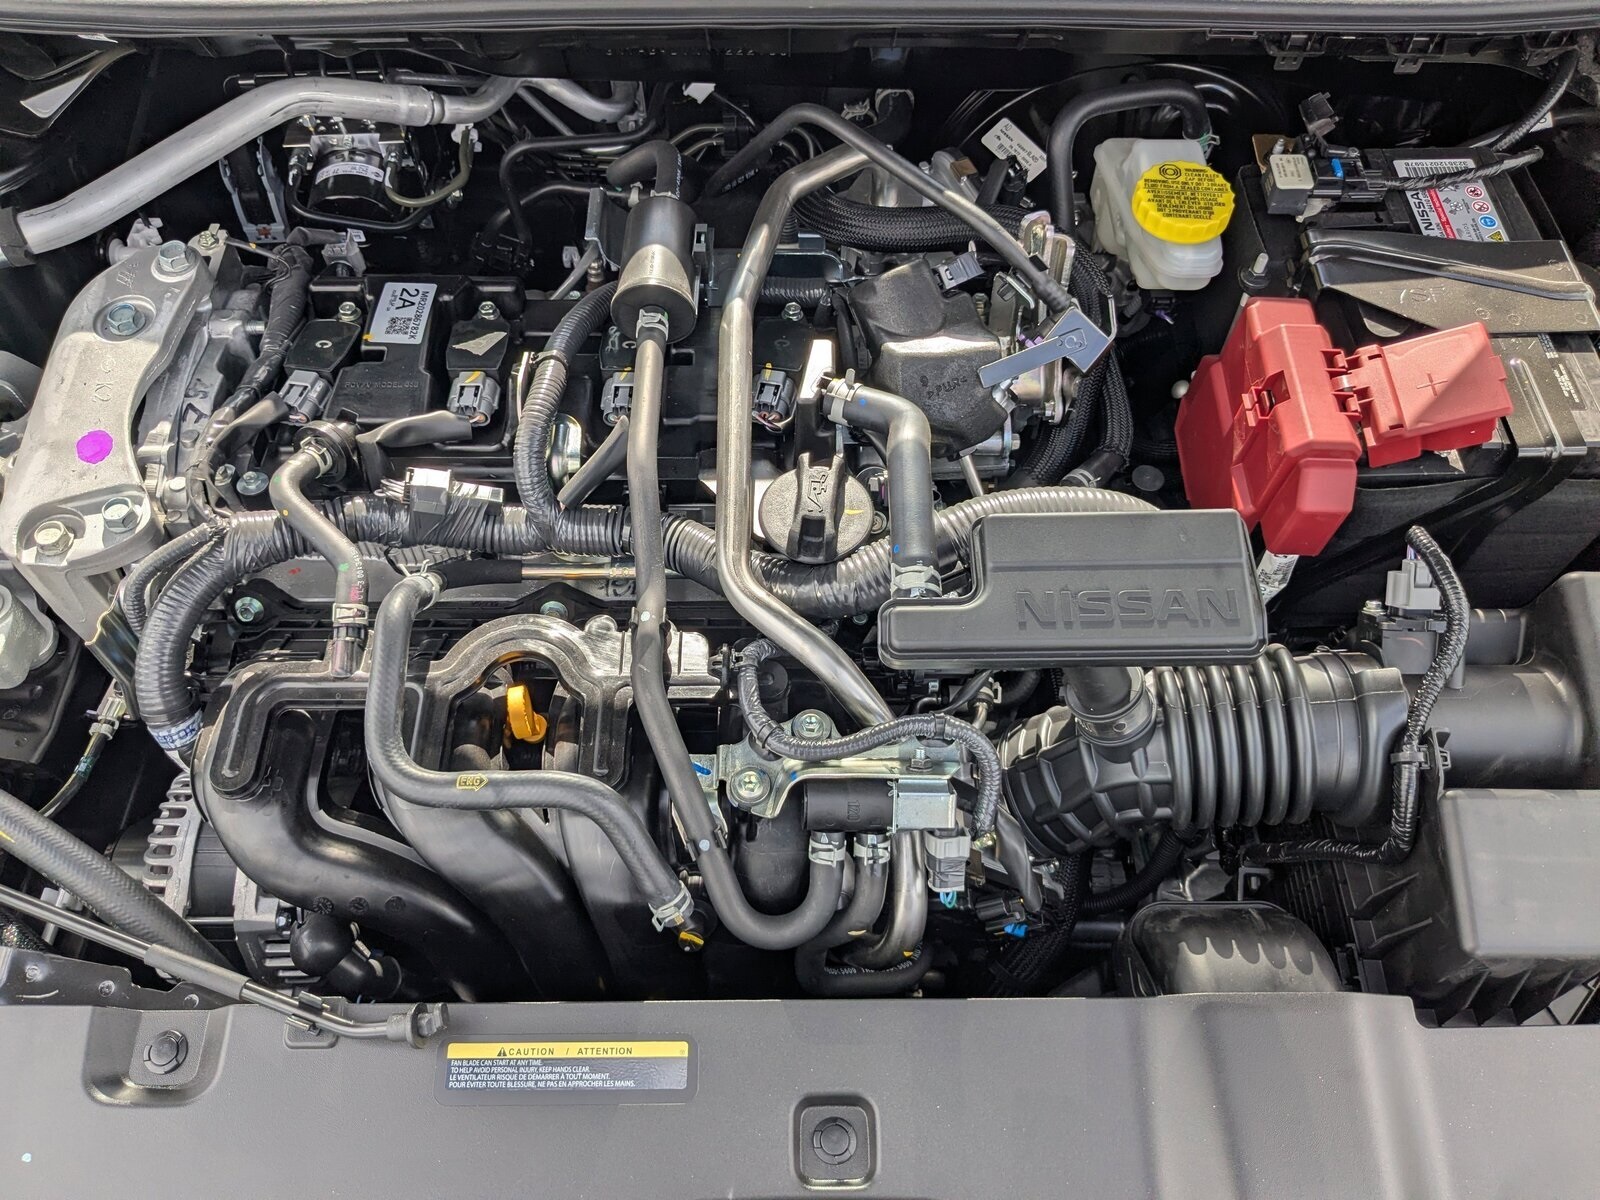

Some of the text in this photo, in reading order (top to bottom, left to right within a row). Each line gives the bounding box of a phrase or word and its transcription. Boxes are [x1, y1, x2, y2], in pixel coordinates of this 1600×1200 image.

[1409, 191, 1435, 230] NISSA
[395, 288, 420, 310] 2A
[1015, 588, 1241, 628] NISSAN
[460, 776, 480, 786] ENG
[508, 1048, 554, 1056] CAUTION
[577, 1047, 633, 1055] ATTENTION
[527, 1072, 559, 1080] DÉMARRER
[466, 1080, 486, 1088] ÉVITER
[486, 1080, 505, 1088] TOUTE
[506, 1080, 536, 1088] BLESSURE,
